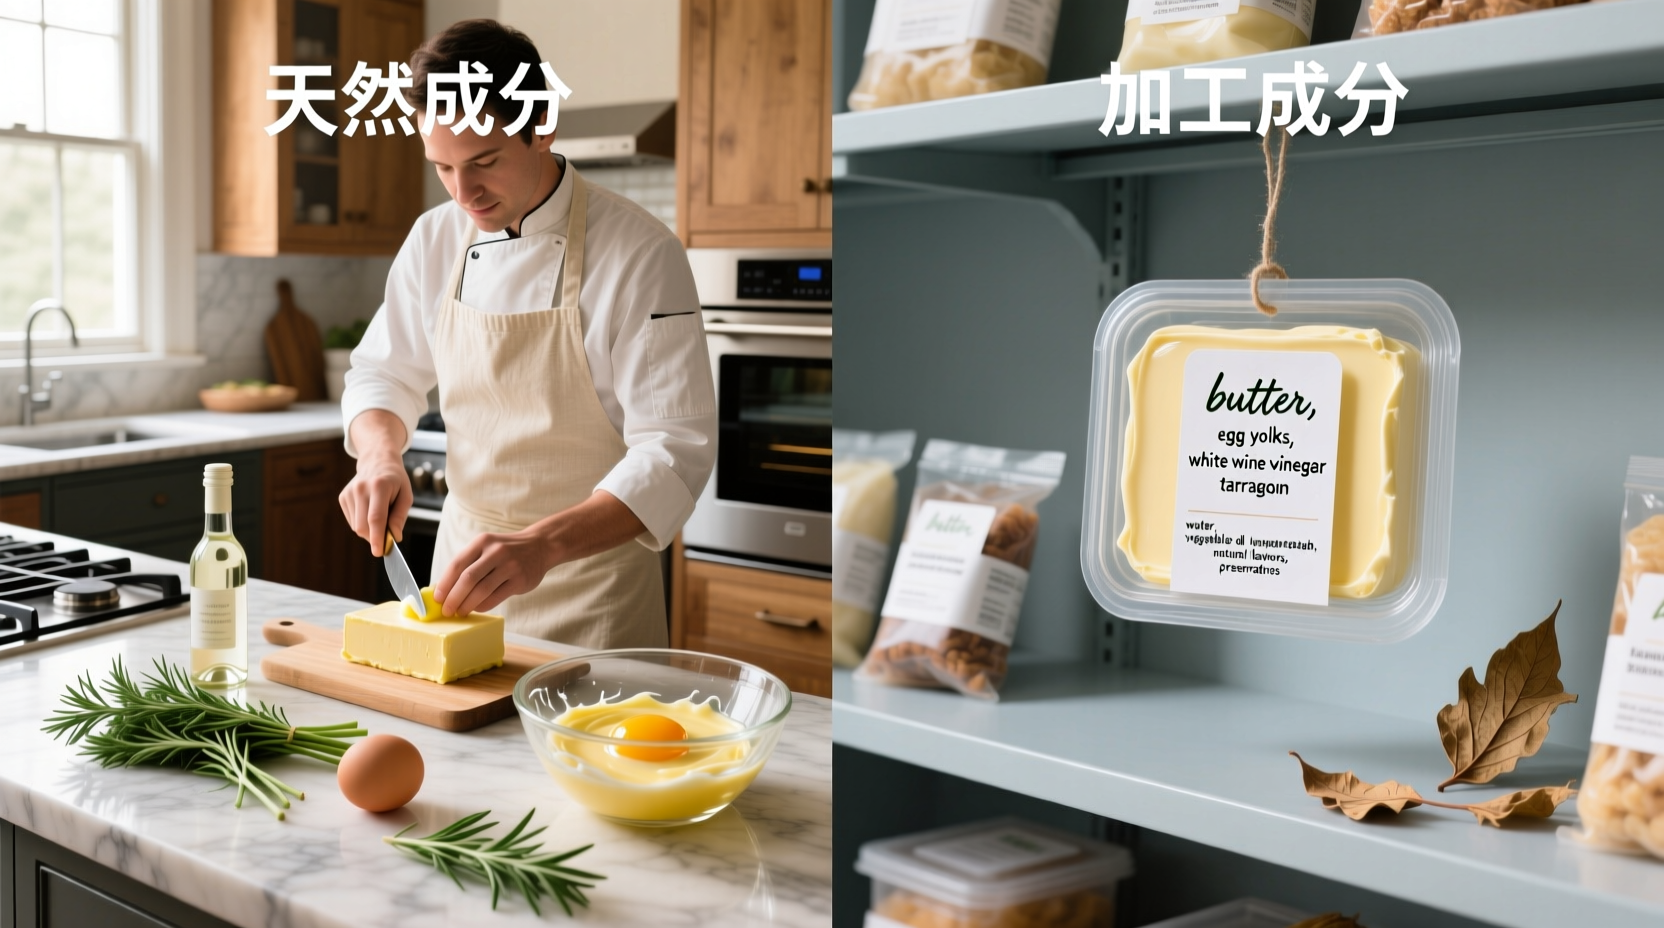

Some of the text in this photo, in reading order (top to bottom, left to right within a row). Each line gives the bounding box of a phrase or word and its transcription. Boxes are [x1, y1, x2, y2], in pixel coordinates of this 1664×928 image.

[1205, 371, 1316, 421] butter,
[1217, 425, 1294, 449] egg yolks,
[1188, 451, 1327, 477] white wine vinegar
